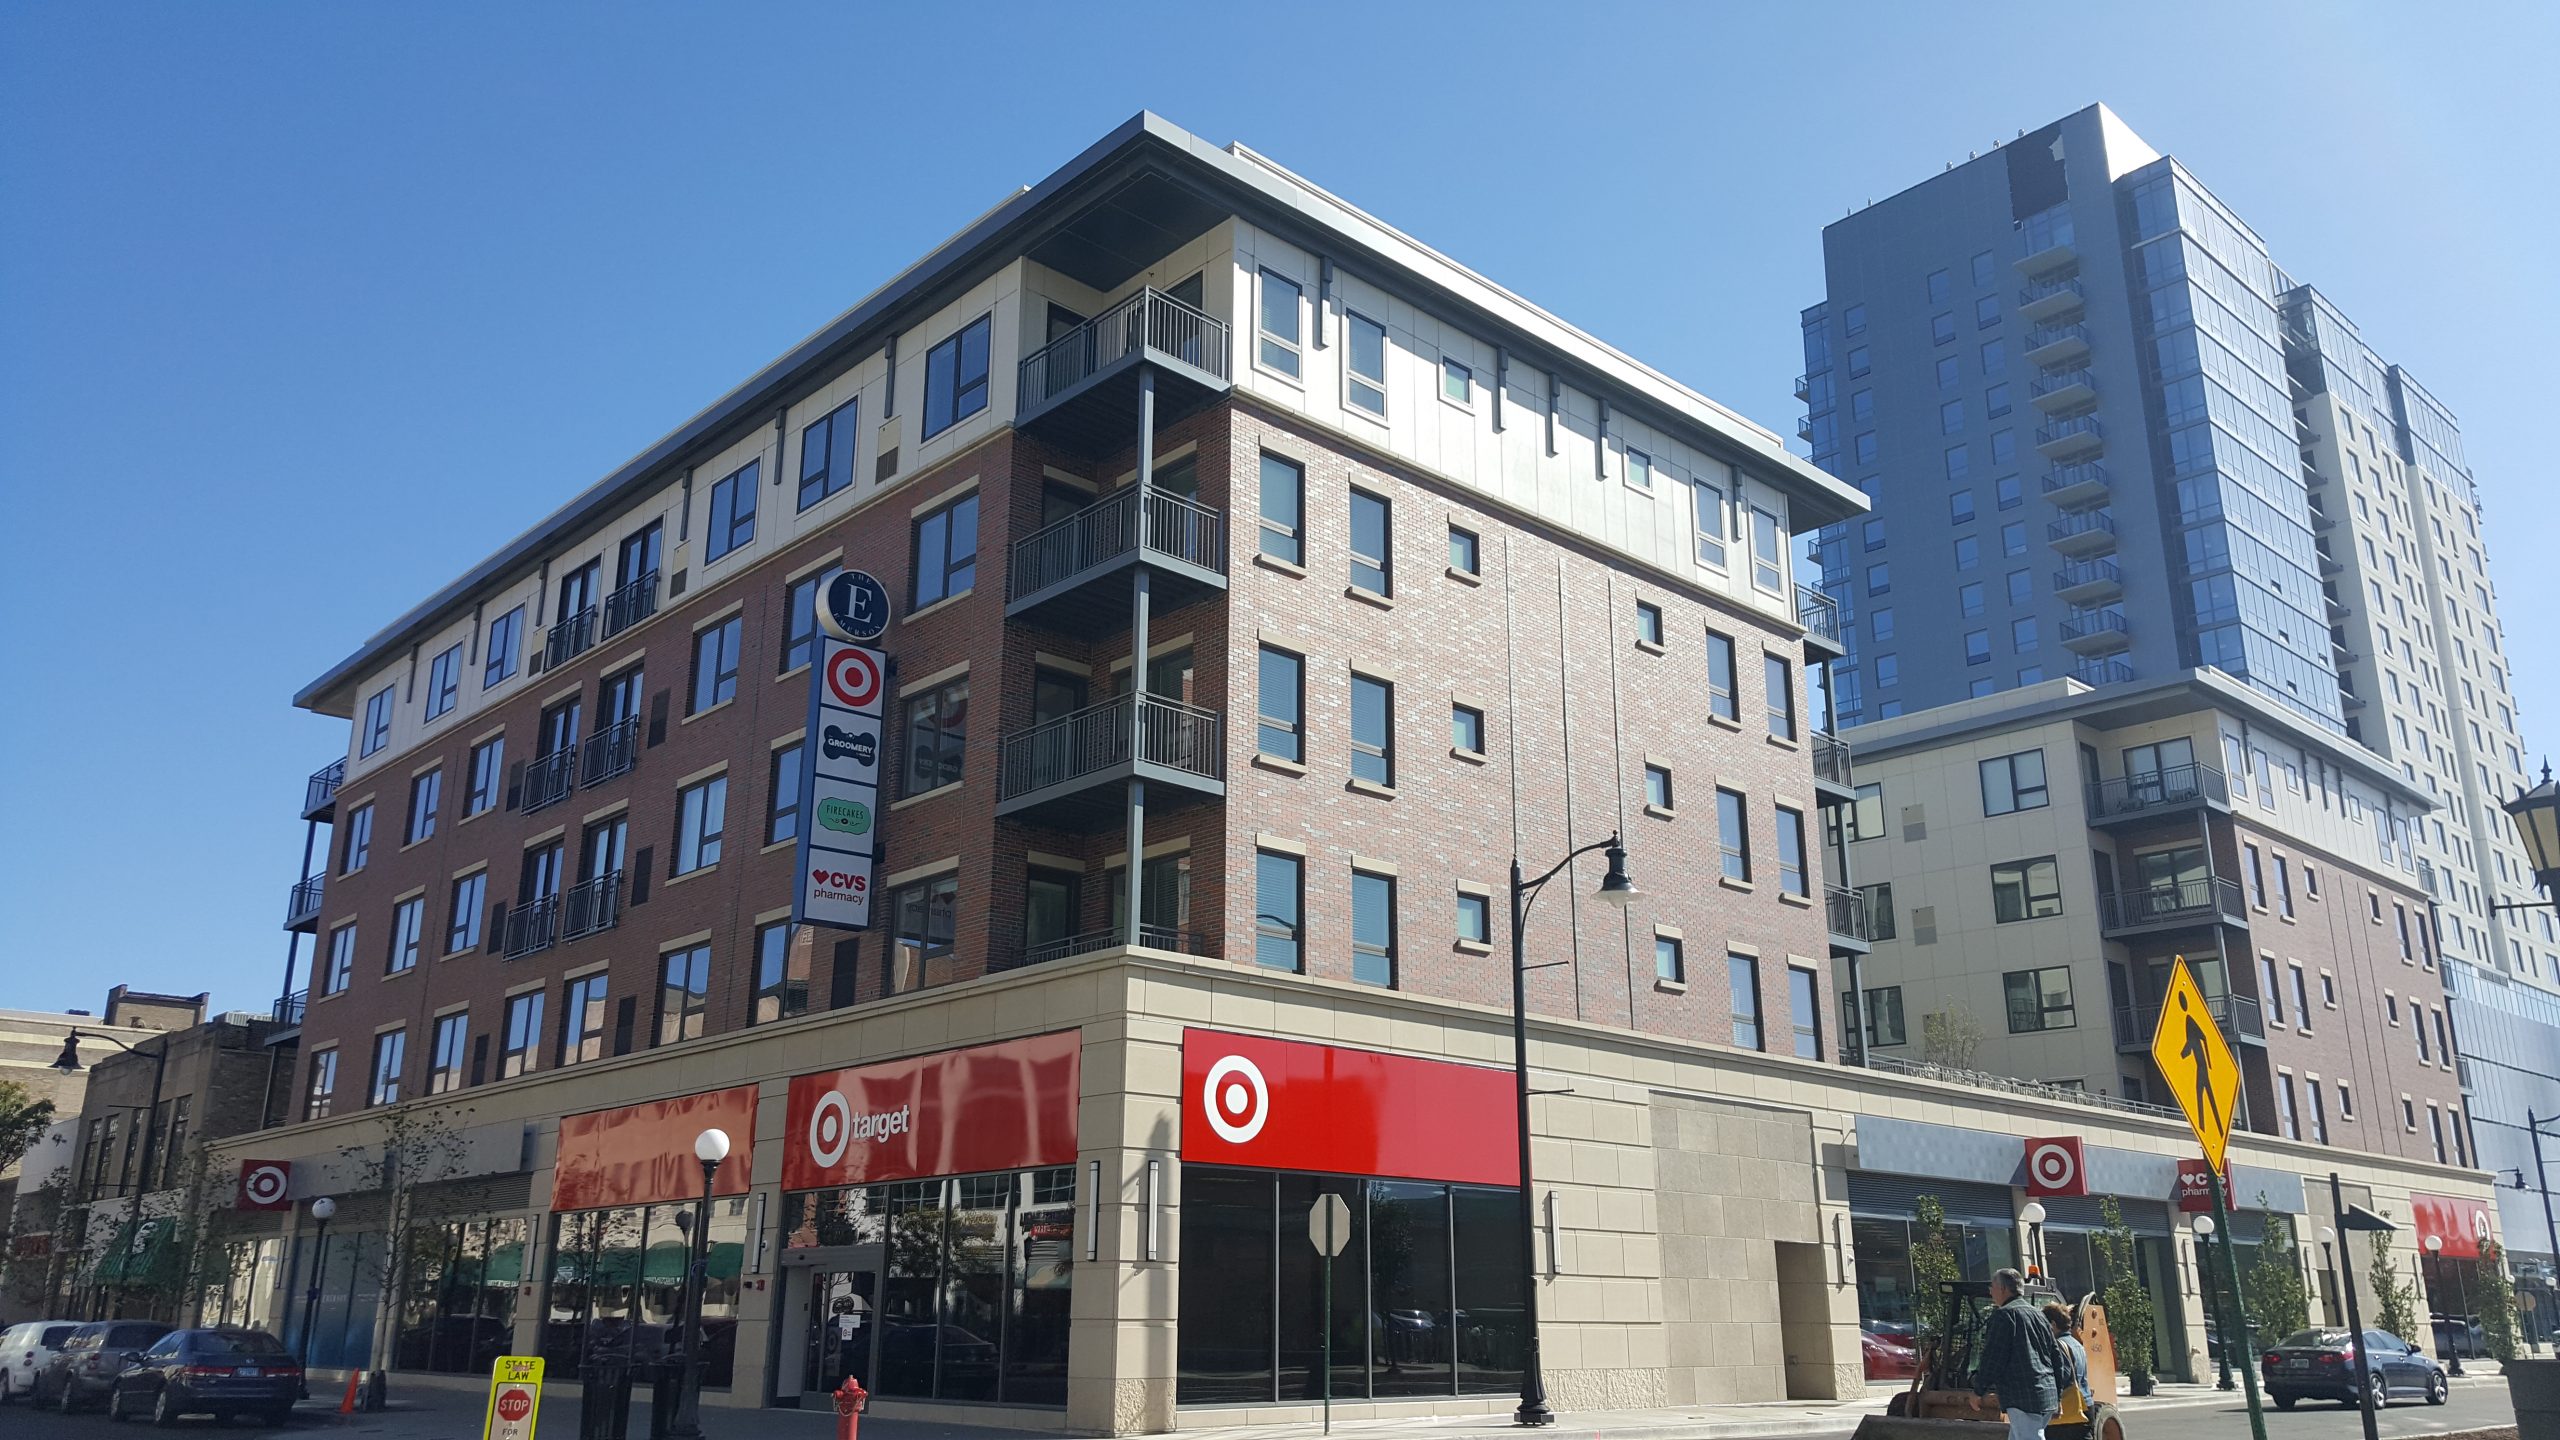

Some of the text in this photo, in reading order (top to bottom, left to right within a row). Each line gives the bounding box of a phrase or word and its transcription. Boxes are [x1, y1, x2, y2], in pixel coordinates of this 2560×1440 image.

[849, 573, 871, 584] THE
[844, 584, 872, 623] E
[833, 612, 881, 637] EMERSON
[828, 738, 873, 754] GROOMERY
[826, 804, 864, 820] FIRECAKES
[830, 872, 866, 892] CVS
[813, 888, 864, 906] pharmacy
[853, 1104, 909, 1143] target
[2195, 1172, 2227, 1186] CS
[2181, 1187, 2228, 1198] pharmy
[505, 1360, 536, 1370] STATE
[508, 1372, 530, 1380] LAW
[500, 1399, 529, 1412] STOP
[502, 1428, 518, 1436] FOR
